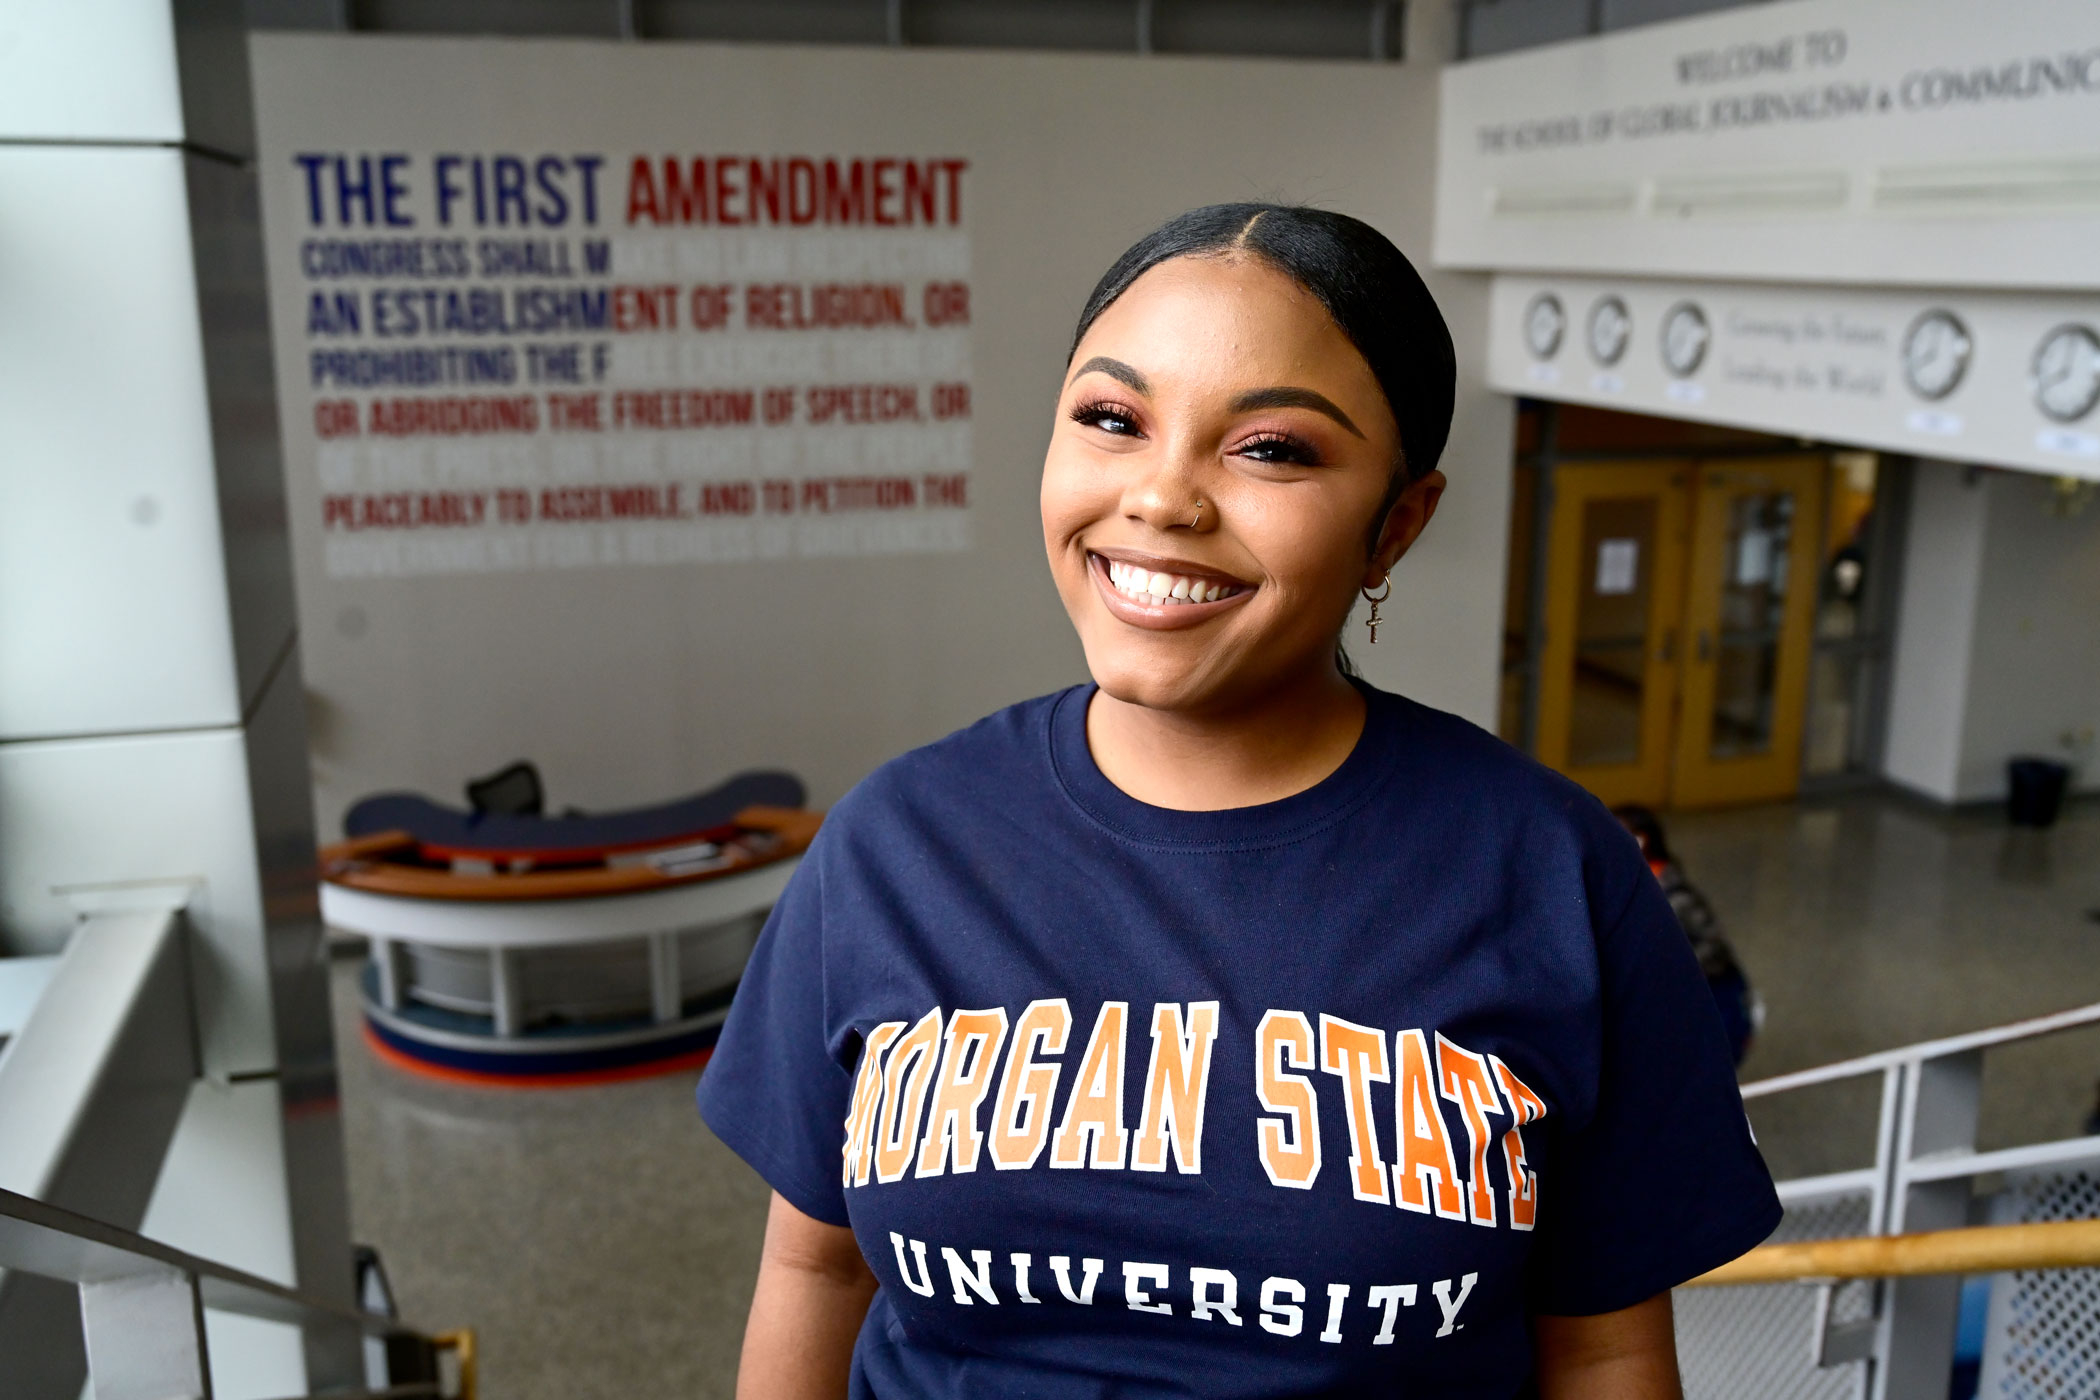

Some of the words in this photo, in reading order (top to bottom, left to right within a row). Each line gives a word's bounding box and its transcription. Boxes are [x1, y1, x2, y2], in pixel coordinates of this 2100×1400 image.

[1677, 38, 1793, 84] WELCOME
[1803, 29, 1848, 67] TO
[1618, 104, 1700, 140] GLOBAL
[1704, 83, 1871, 136] JOURNALISM
[294, 155, 415, 227] THE
[435, 155, 604, 228] FIRST
[626, 155, 969, 227] AMENDMENT
[302, 239, 469, 278] CONGRESS
[480, 239, 573, 277] SHALL
[308, 290, 360, 335] AN
[372, 285, 679, 336] ESTABLISHMENT
[689, 284, 732, 331] OF
[744, 284, 916, 332] RELIGION,
[923, 281, 970, 327] OR
[311, 348, 517, 388] PROHIBITING
[526, 345, 580, 384] THE
[315, 398, 360, 439] OR
[368, 395, 539, 436] ABRIDGING
[546, 391, 604, 433] THE
[612, 388, 754, 430] FREEDOM
[761, 386, 796, 428] OF
[805, 383, 925, 425] SPEECH,
[930, 381, 971, 421] OR
[323, 493, 485, 531] PEACEABLY
[496, 488, 532, 525] TO
[540, 484, 692, 523] ASSEMBLE,
[701, 481, 755, 517] AND
[761, 479, 796, 516] TO
[803, 476, 916, 513] PETITION
[922, 473, 967, 509] THE
[842, 998, 1220, 1188] MORGAN
[1255, 1008, 1547, 1231] STATE
[889, 1231, 1478, 1345] UNIVERSITY
